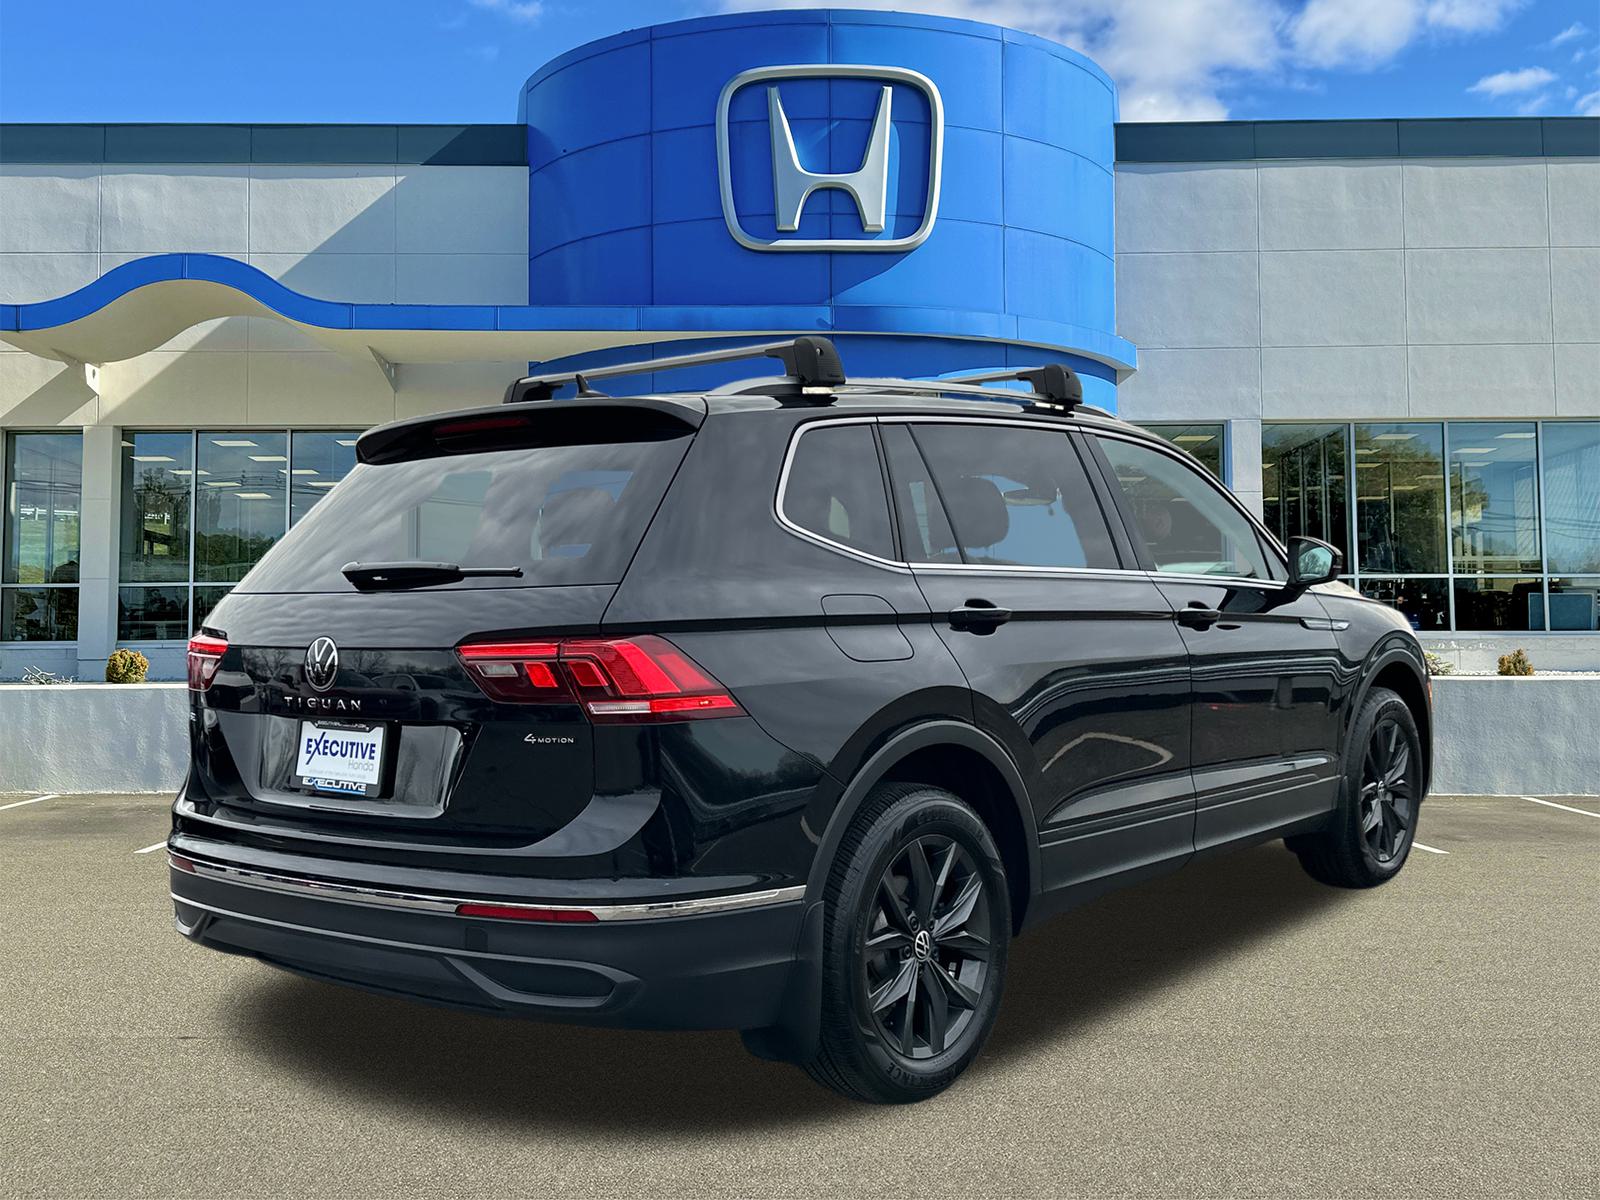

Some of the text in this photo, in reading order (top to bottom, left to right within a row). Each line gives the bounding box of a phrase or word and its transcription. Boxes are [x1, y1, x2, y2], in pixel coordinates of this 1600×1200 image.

[284, 696, 361, 711] TIGUAN
[305, 731, 376, 766] EXECUTIVE
[347, 759, 375, 772] Honda
[302, 776, 367, 792] EXECUTIVE
